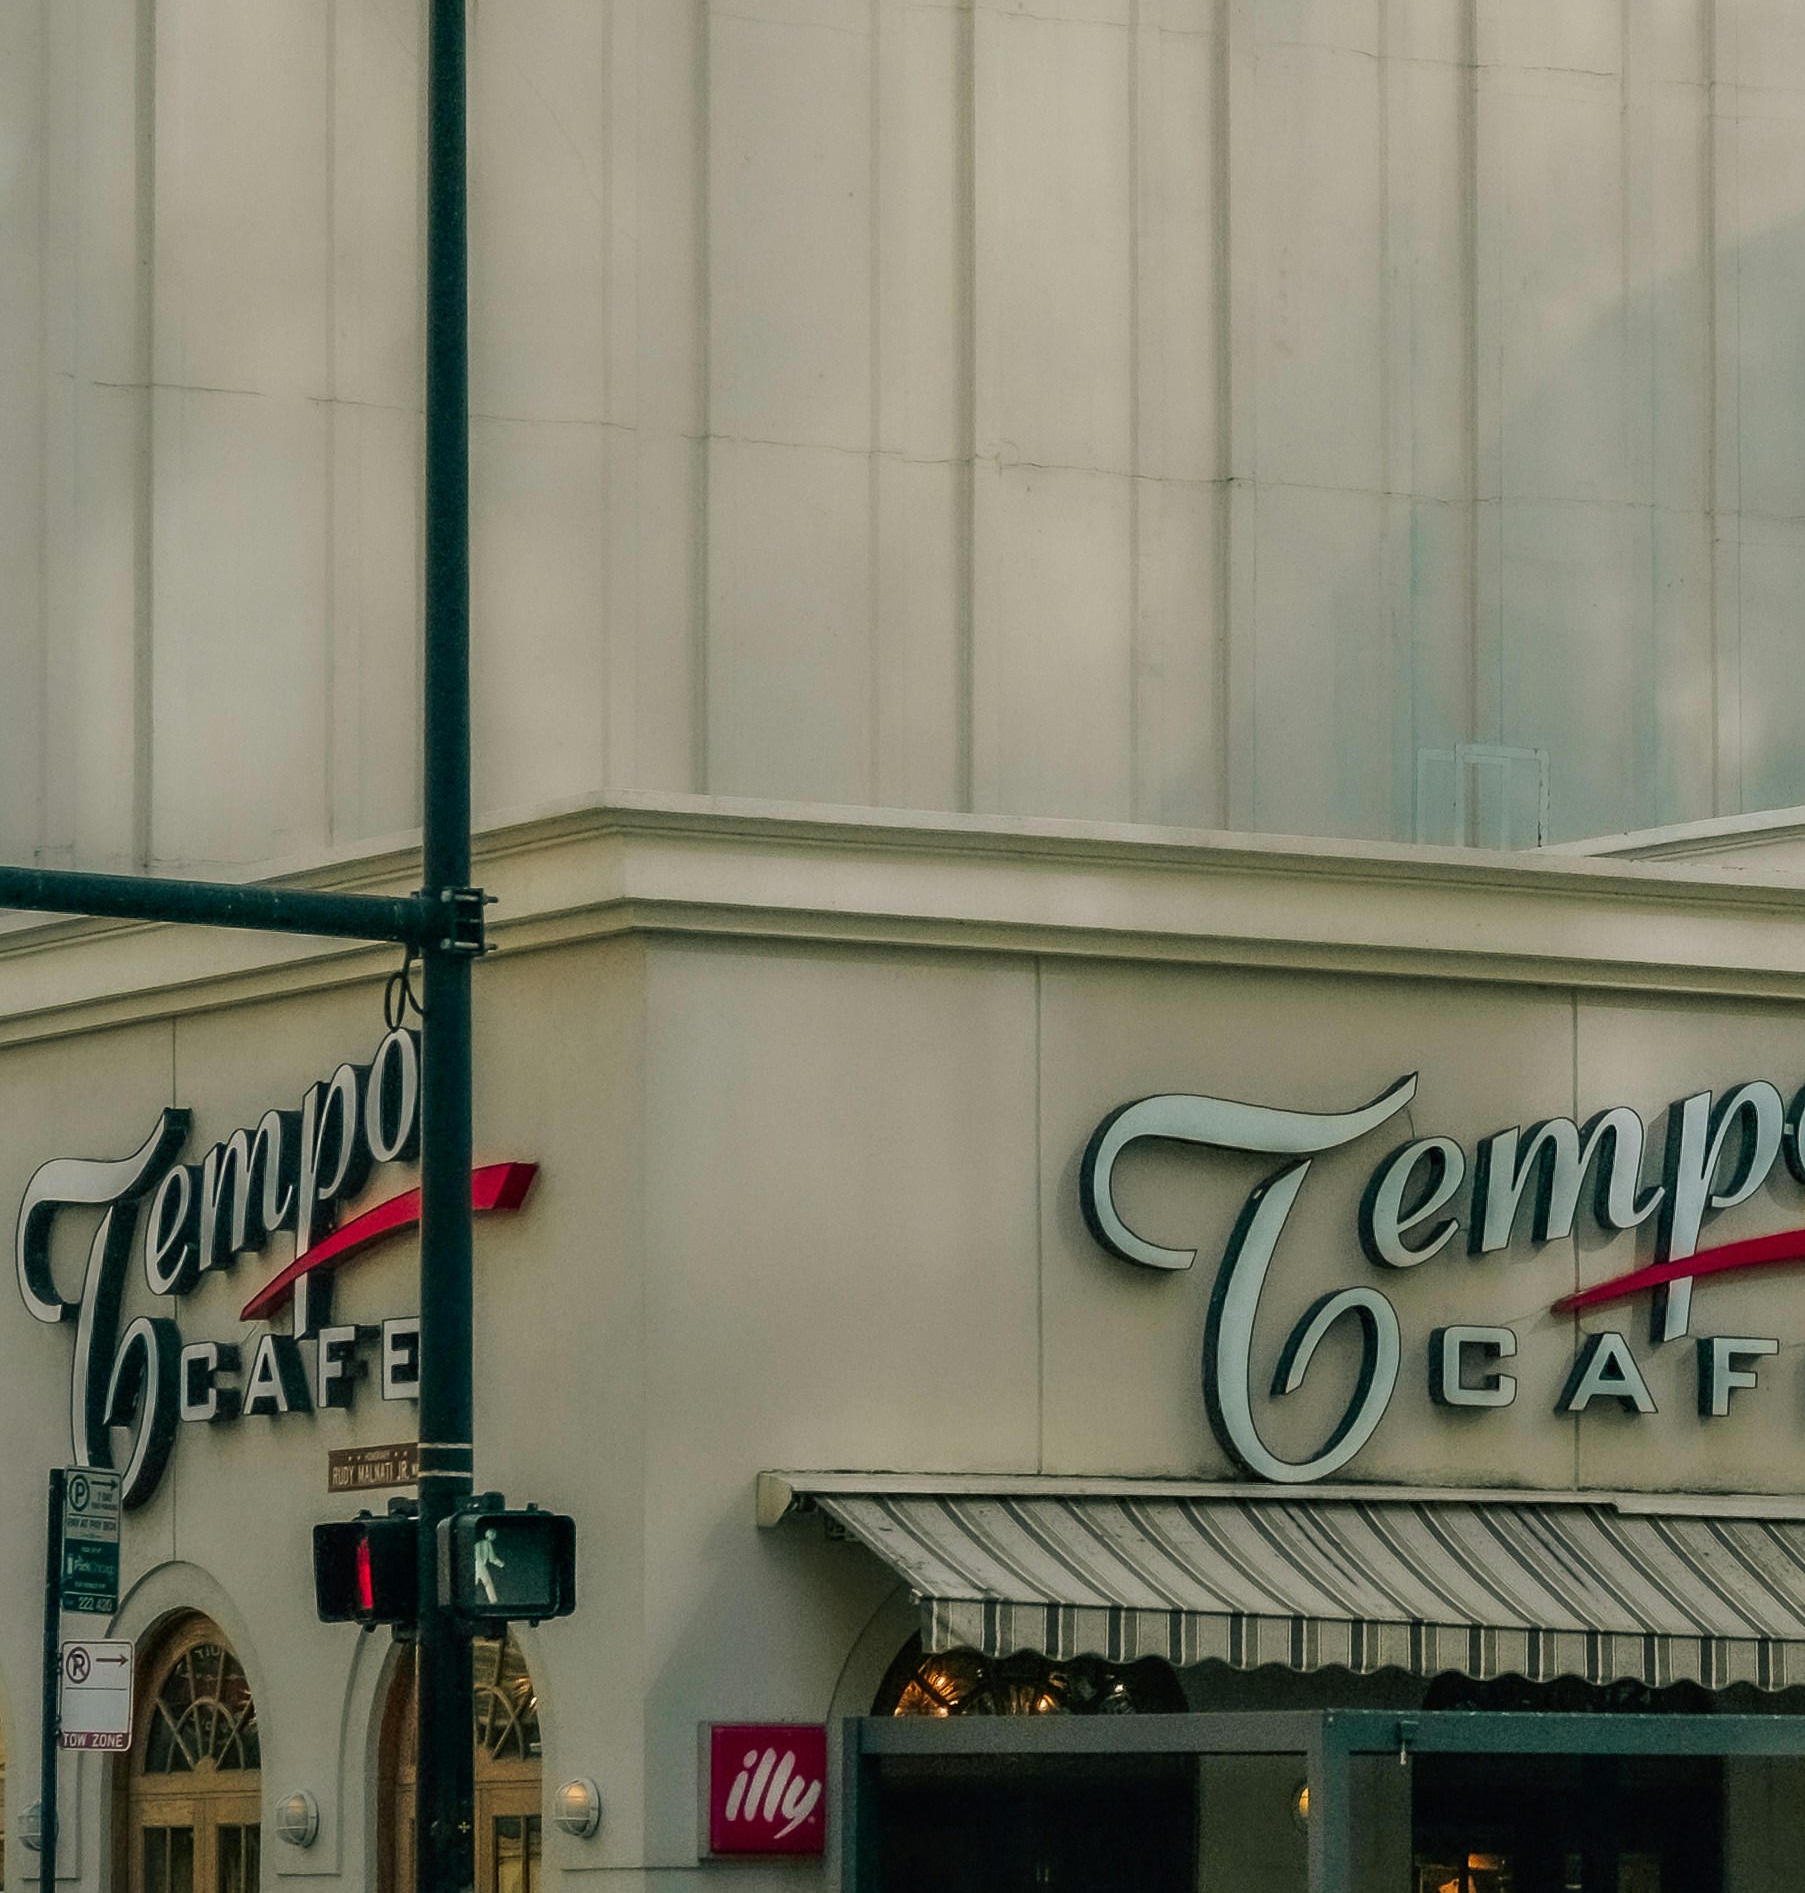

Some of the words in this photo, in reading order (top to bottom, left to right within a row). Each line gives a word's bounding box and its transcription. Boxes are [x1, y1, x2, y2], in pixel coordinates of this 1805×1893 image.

[16, 1027, 420, 1510] Tempo
[180, 1316, 420, 1422] CAFE
[333, 1466, 354, 1486] RUDY
[63, 1733, 87, 1747] TOW
[92, 1733, 124, 1747] ZONE
[725, 1747, 822, 1840] illy
